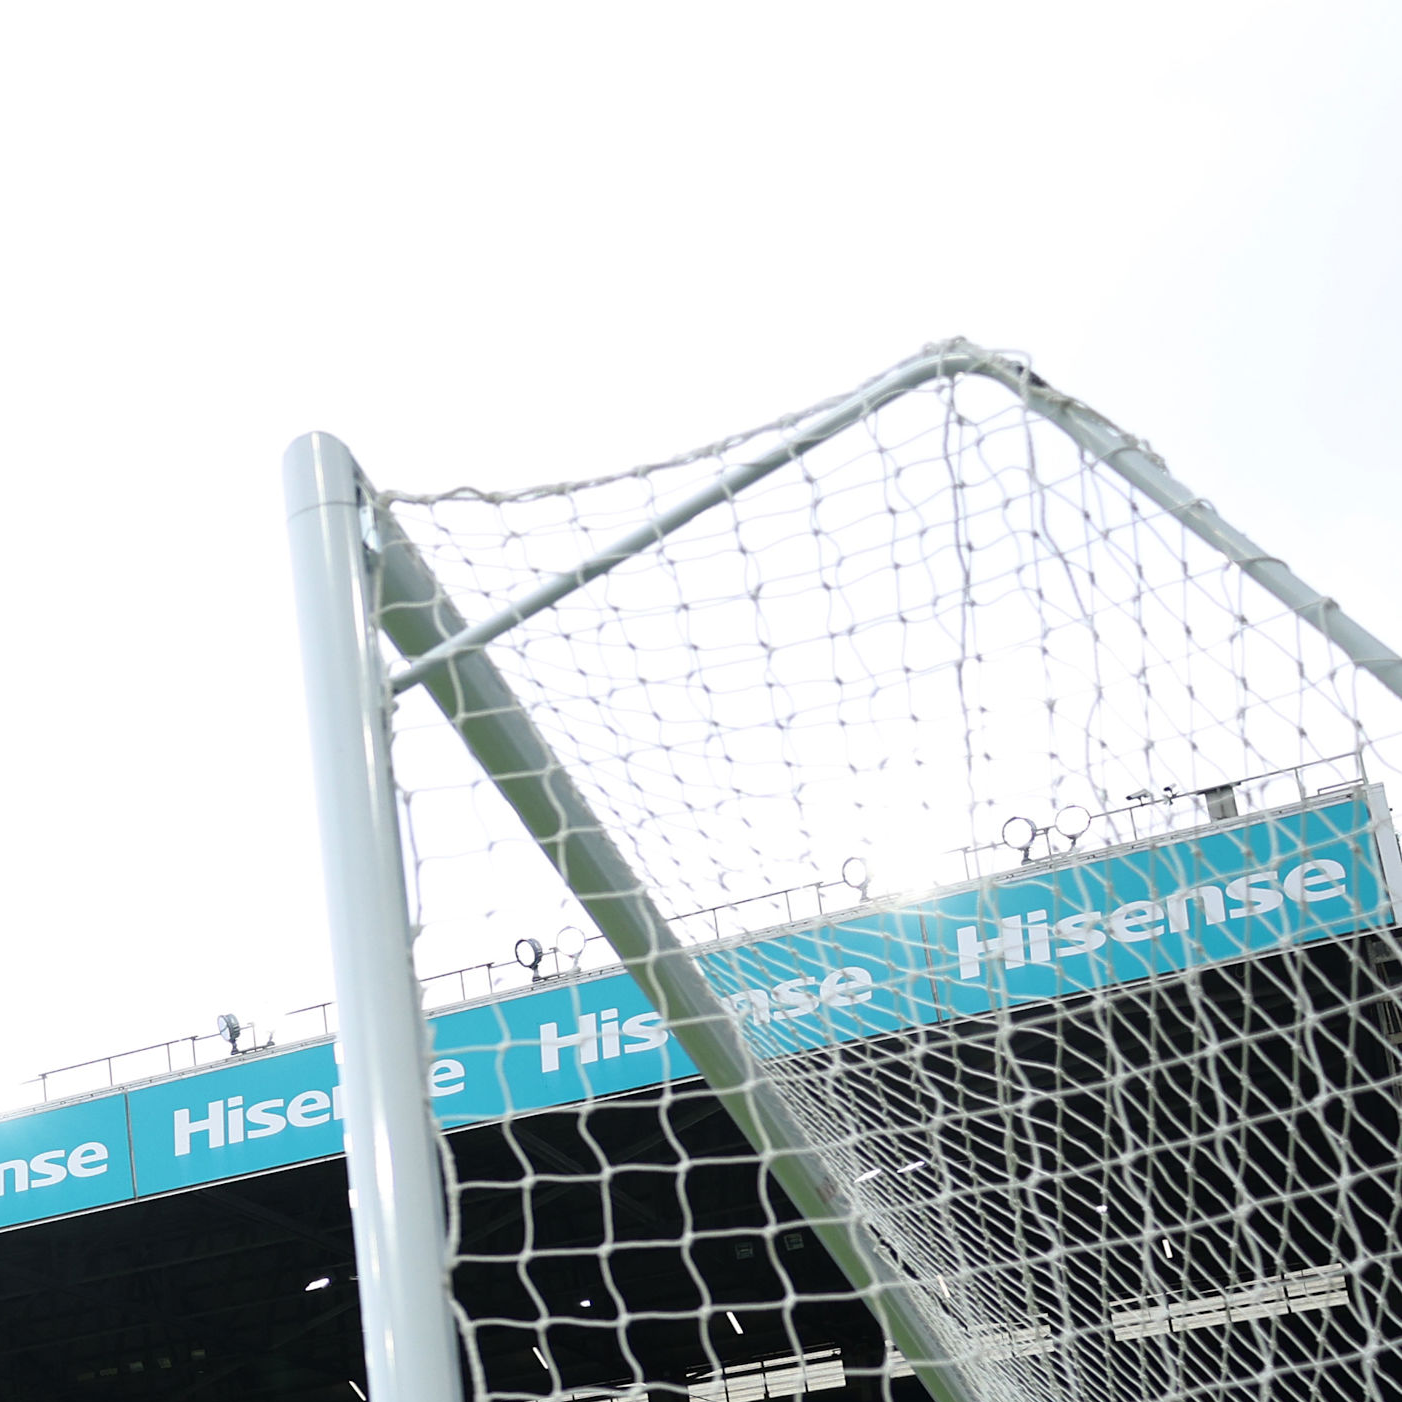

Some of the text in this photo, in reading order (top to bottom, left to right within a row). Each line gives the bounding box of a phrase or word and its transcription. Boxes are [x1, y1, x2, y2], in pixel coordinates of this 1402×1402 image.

[956, 858, 1347, 979] Hisense
[539, 965, 873, 1073] Hisnse
[173, 1057, 466, 1157] Hisee
